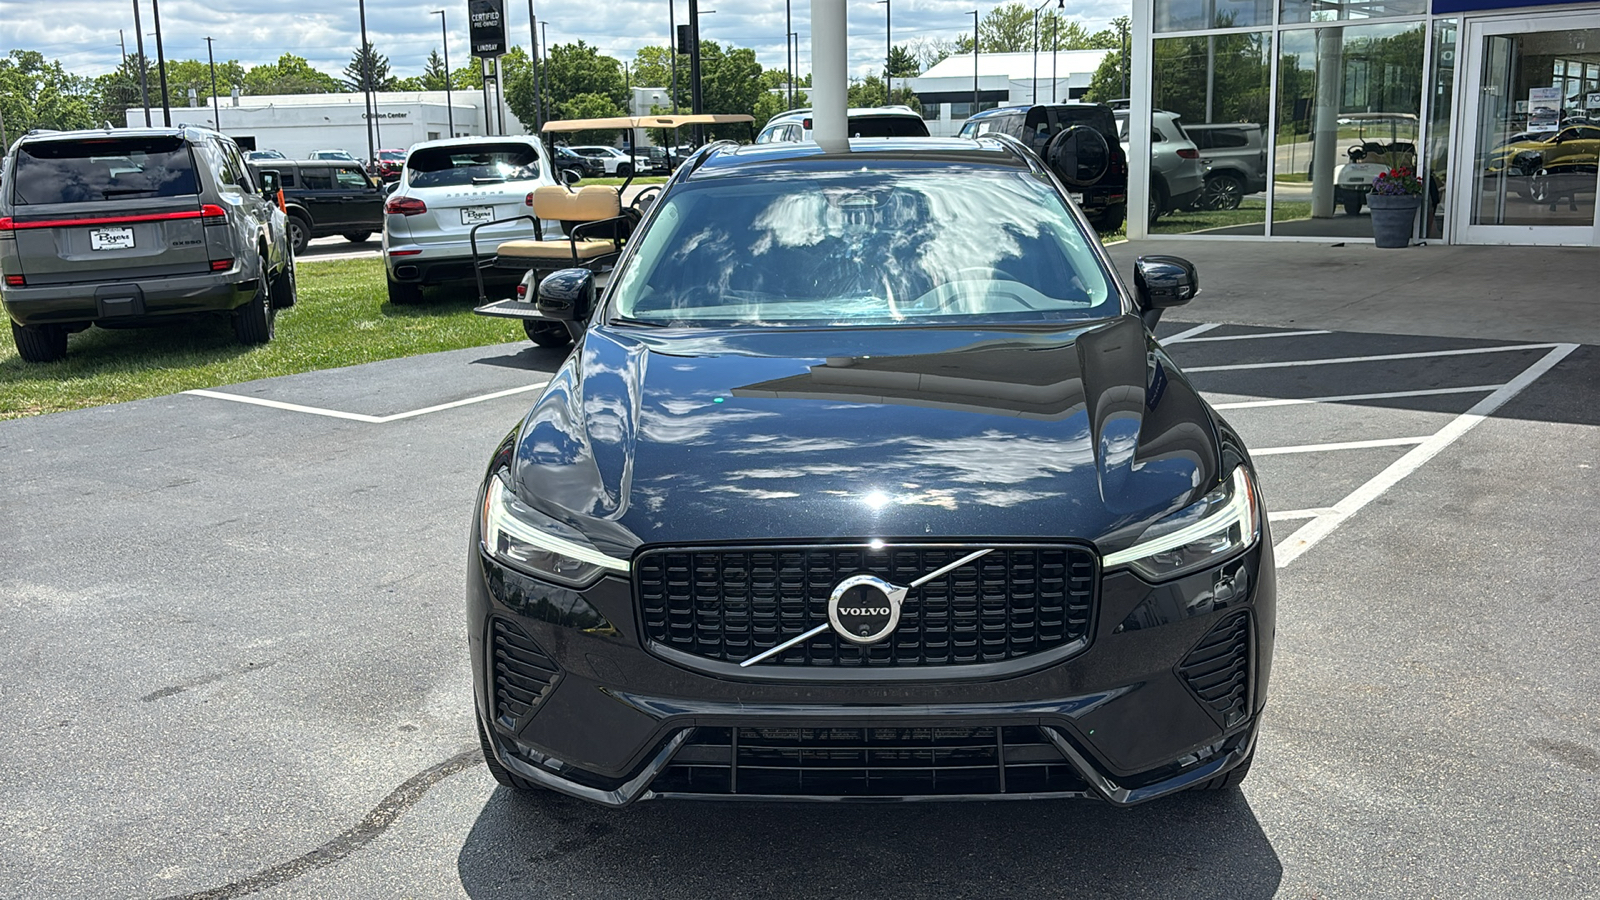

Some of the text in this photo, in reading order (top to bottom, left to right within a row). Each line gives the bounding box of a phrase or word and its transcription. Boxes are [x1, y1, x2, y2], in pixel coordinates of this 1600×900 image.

[472, 12, 499, 21] CERTIFIED
[94, 232, 130, 244] Byers
[838, 607, 890, 616] VOLVO
